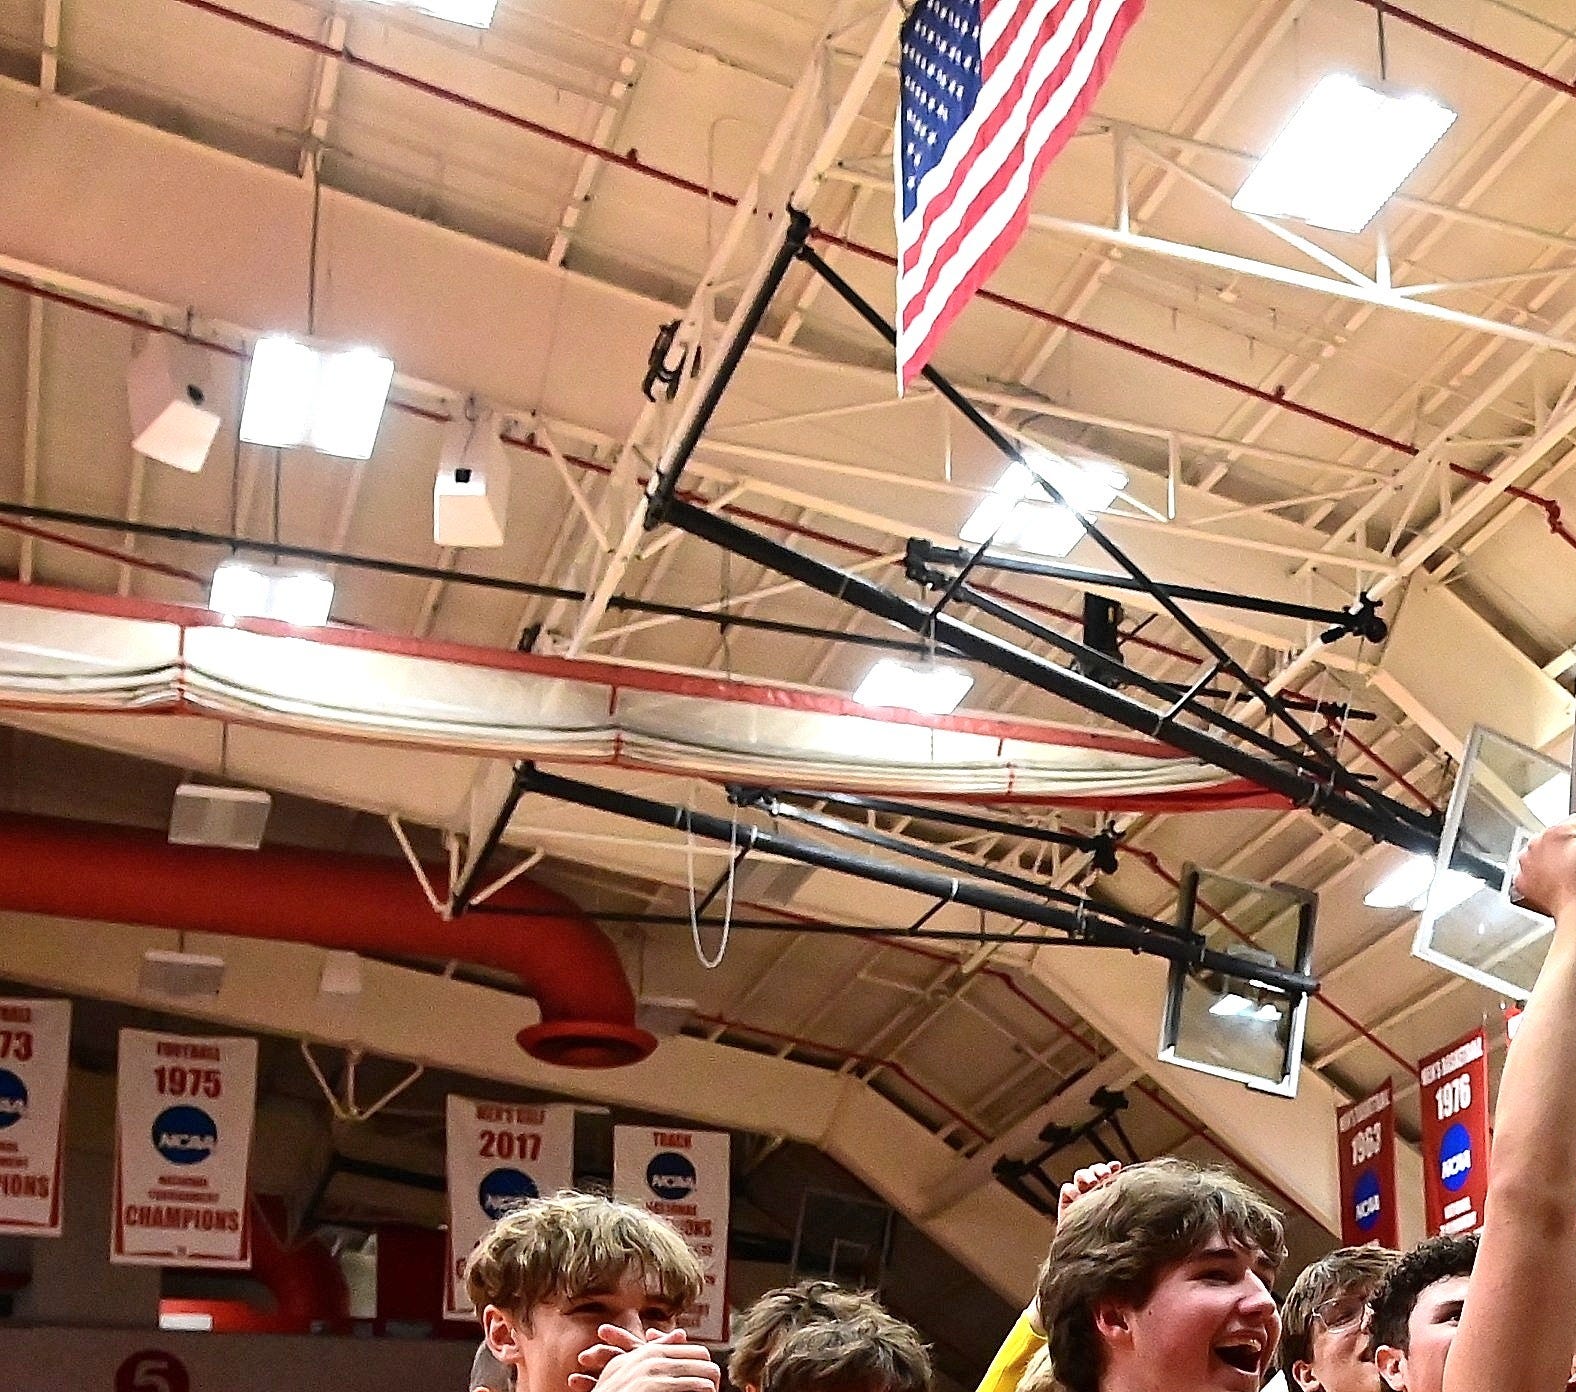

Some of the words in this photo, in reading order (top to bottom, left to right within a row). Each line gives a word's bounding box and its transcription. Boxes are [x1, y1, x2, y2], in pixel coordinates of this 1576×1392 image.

[154, 1066, 221, 1098] 1975
[1435, 1073, 1472, 1120] 1976
[479, 1130, 542, 1160] 2017
[125, 1203, 239, 1231] CHAMPIONS
